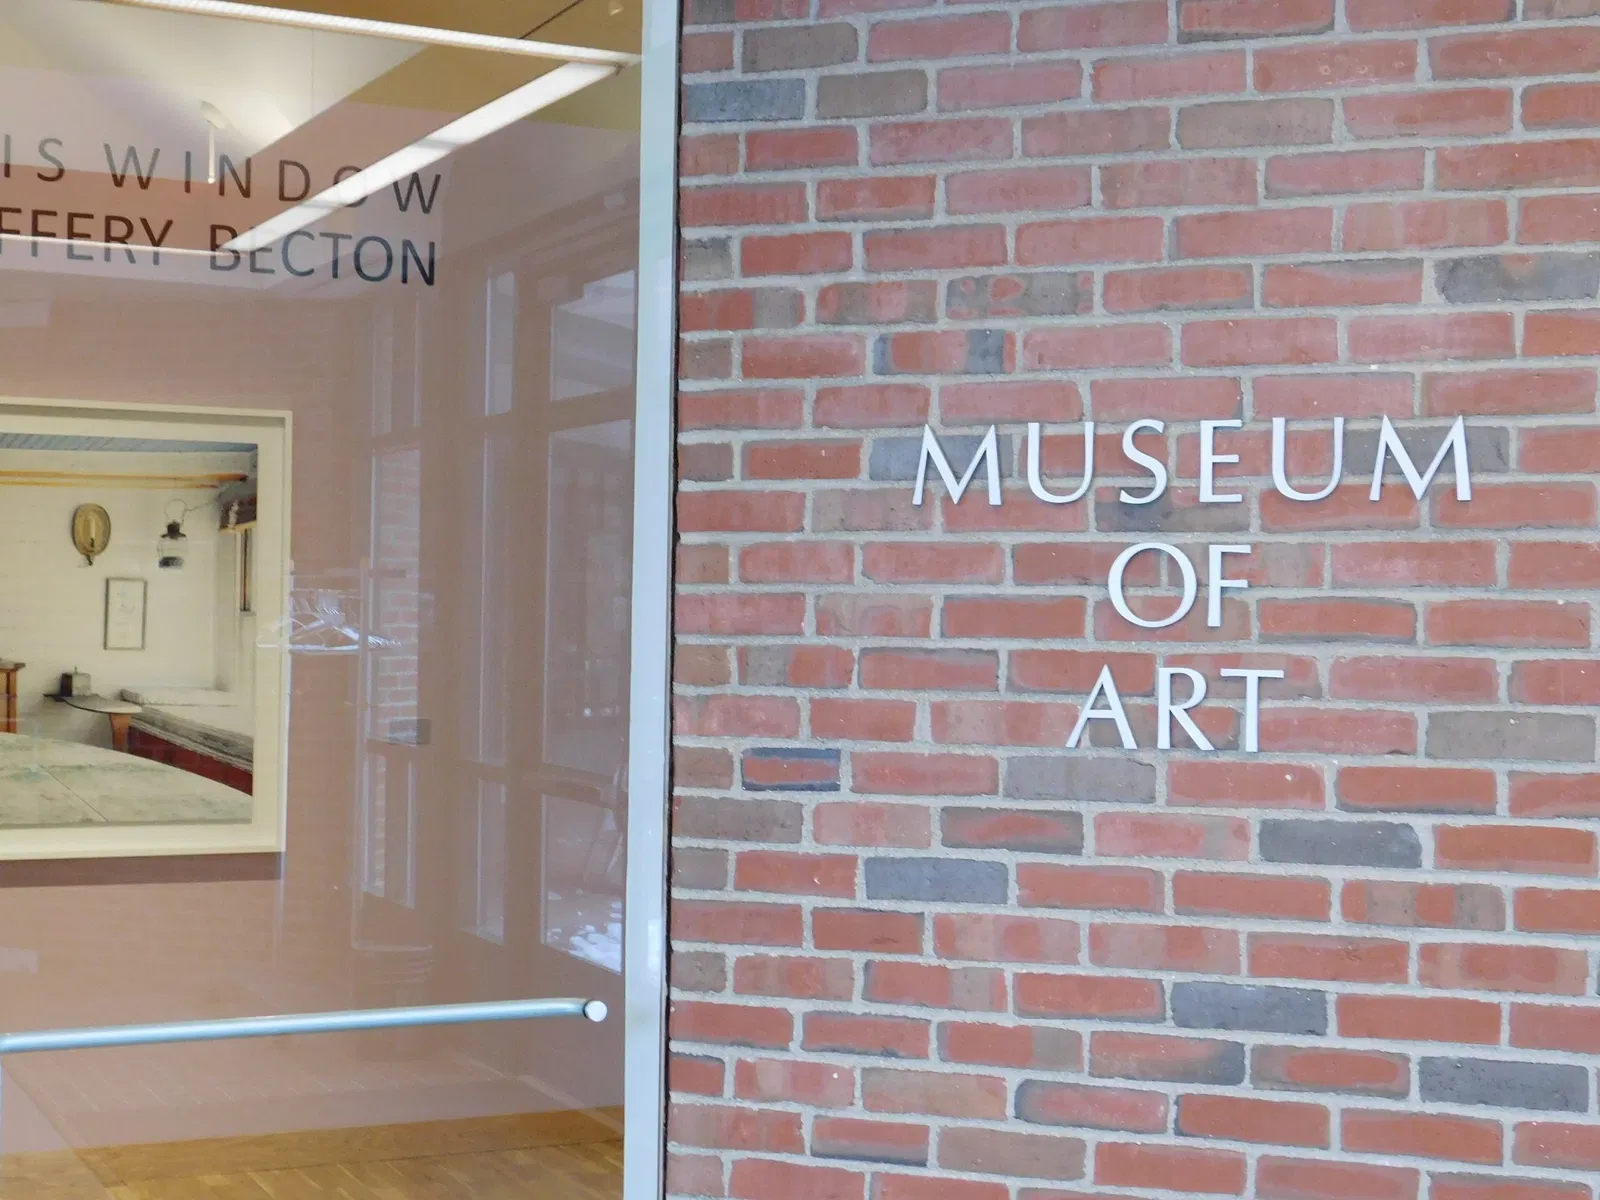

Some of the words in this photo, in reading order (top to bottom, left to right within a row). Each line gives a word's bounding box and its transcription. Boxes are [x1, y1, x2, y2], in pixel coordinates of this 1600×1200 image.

[3, 134, 66, 182] IS
[103, 142, 441, 214] WINDOW
[0, 206, 174, 265] FFERY
[209, 224, 436, 286] BECTON
[911, 415, 1472, 506] MUSEUM
[1107, 541, 1252, 629] OF
[1065, 663, 1285, 753] ART
